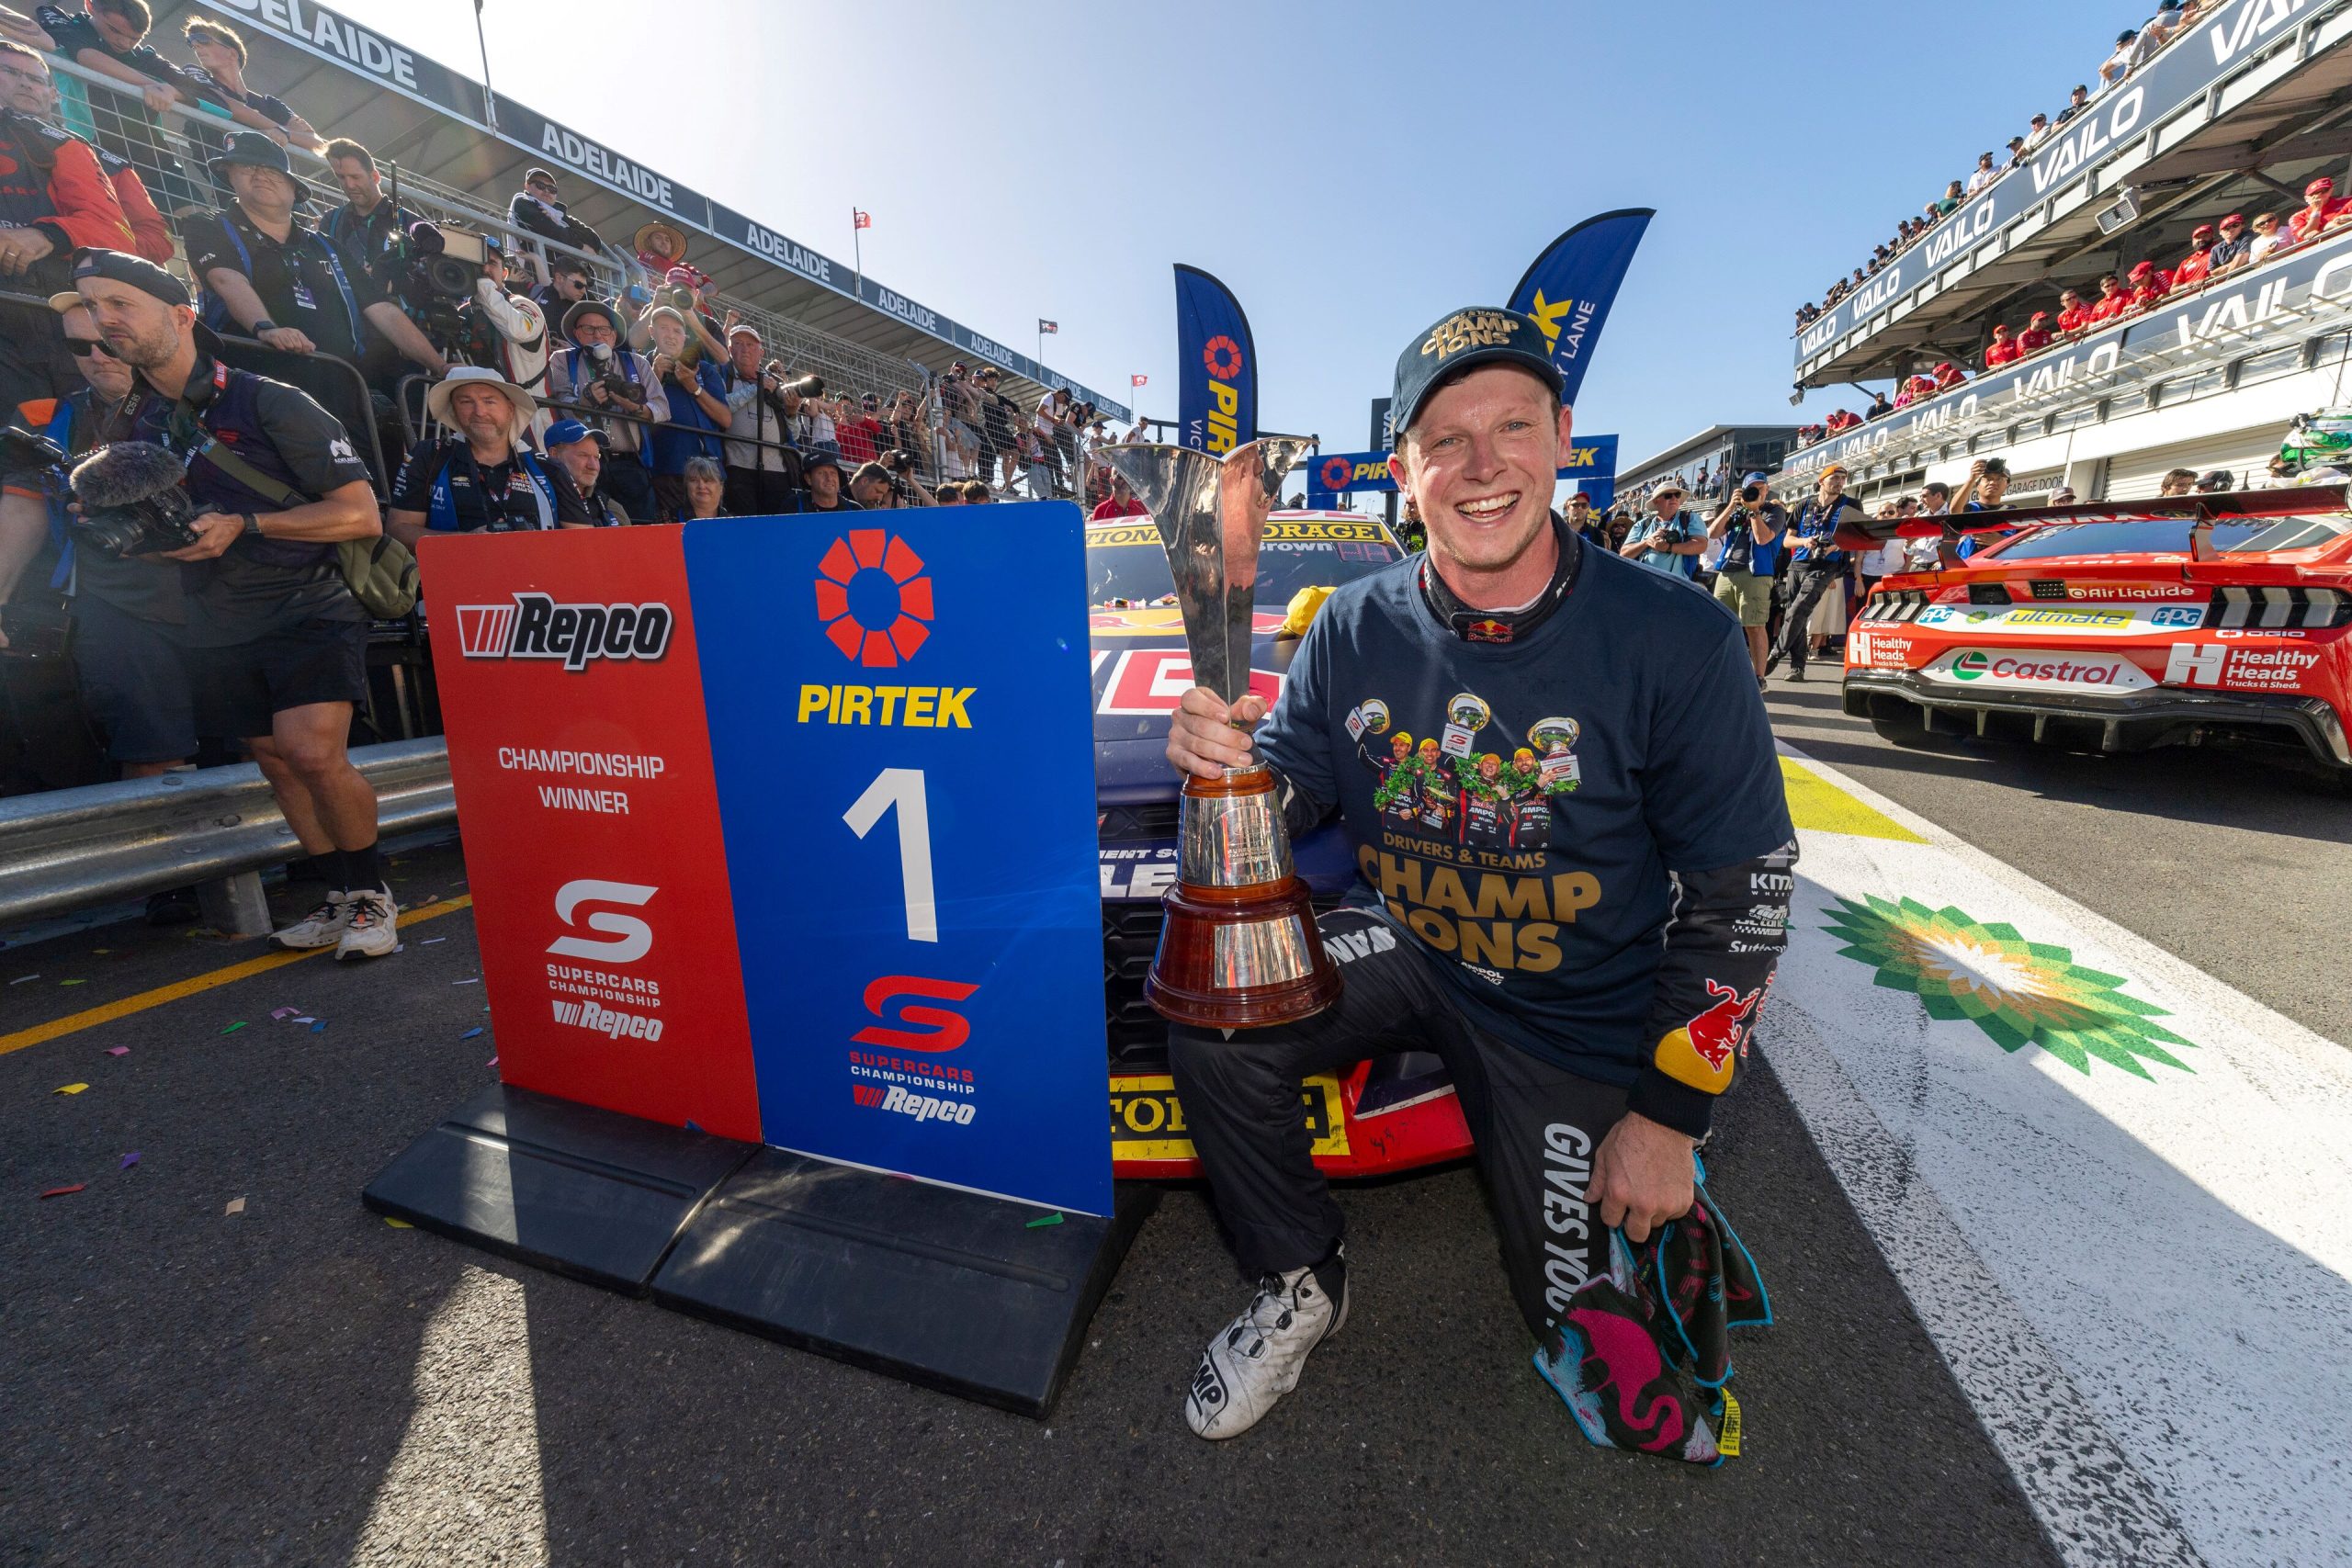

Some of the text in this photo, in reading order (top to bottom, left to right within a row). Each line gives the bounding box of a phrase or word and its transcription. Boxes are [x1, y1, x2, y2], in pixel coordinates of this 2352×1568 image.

[2031, 85, 2144, 194] VAILO
[542, 123, 673, 209] ADELAIDE
[1926, 198, 1995, 268] VAILO
[746, 223, 830, 282] ADELAIDE
[878, 288, 936, 332] ADELAIDE
[1853, 268, 1900, 321] VAILO
[1421, 316, 1519, 355] CHAMP
[1439, 330, 1510, 360] IONS
[1561, 299, 1596, 359] LANE
[1802, 316, 1836, 356] VAILO
[971, 333, 1012, 367] ADELAIDE
[1051, 374, 1081, 400] ADELAIDE
[2014, 342, 2119, 405] VAILO
[1098, 396, 1123, 416] ADELAIDE
[1911, 393, 1978, 435] VAILO
[1191, 419, 1203, 451] VIC
[1842, 426, 1887, 461] VAILO
[1352, 462, 1390, 481] PIR
[1793, 449, 1827, 474] VAILO
[2007, 479, 2038, 496] GARAGE
[2039, 475, 2064, 490] DOOR
[1261, 523, 1375, 540] ORAGE
[2088, 586, 2194, 599] Air Liquide
[1921, 607, 1953, 623] PPG
[2009, 610, 2125, 626] ultimate
[2153, 609, 2199, 625] PPG
[508, 592, 672, 671] Repco
[1871, 637, 1912, 651] Healthy
[1872, 649, 1905, 660] Heads
[2230, 650, 2320, 670] Healthy
[1992, 657, 2120, 685] Castrol
[2226, 680, 2259, 688] Trucks
[2269, 681, 2301, 689] Sheds
[2227, 665, 2298, 680] Heads
[797, 684, 978, 728] PIRTEK
[498, 747, 665, 780] CHAMPIONSHIP
[538, 785, 629, 815] WINNER
[1469, 807, 1497, 818] AMPOL
[842, 767, 938, 943] 1
[1383, 831, 1546, 870] DRIVERS & TEAMS
[1358, 844, 1601, 923] CHAMP
[1387, 902, 1562, 973] IONS
[547, 964, 660, 995] SUPERCARS
[548, 979, 662, 1008] CHAMPIONSHIP
[580, 999, 663, 1042] Repco
[850, 1051, 974, 1083] SUPERCARS
[851, 1066, 975, 1094] CHAMPIONSHIP
[882, 1085, 976, 1125] Repco
[1544, 1122, 1591, 1241] GIVES
[1194, 1355, 1222, 1404] MP
